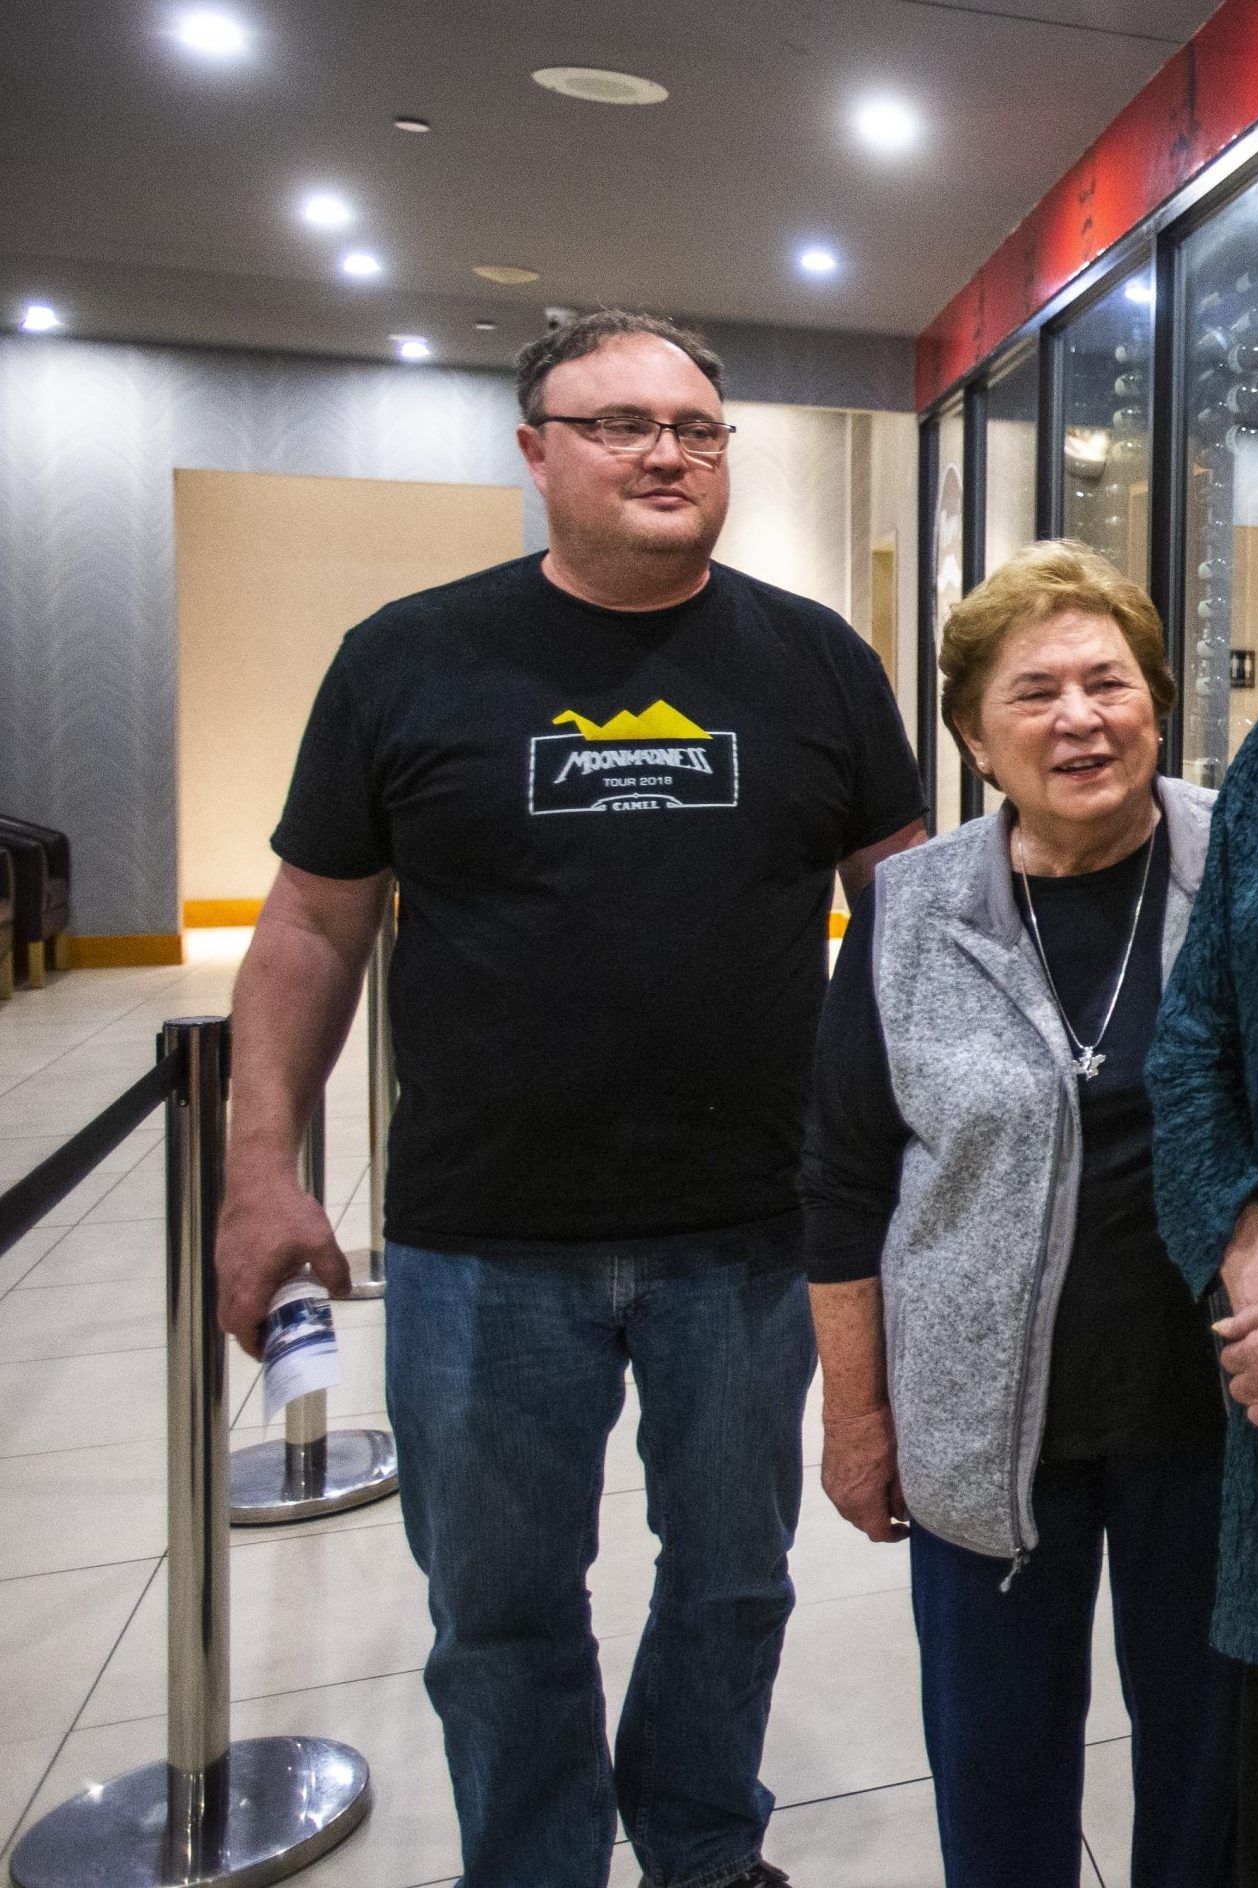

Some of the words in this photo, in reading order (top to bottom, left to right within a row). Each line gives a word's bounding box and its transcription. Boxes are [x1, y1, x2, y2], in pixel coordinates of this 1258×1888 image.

[553, 747, 713, 784] MOONMADNESS
[603, 778, 636, 787] TOUR
[639, 776, 673, 786] 2018
[612, 800, 660, 811] CAMEL
